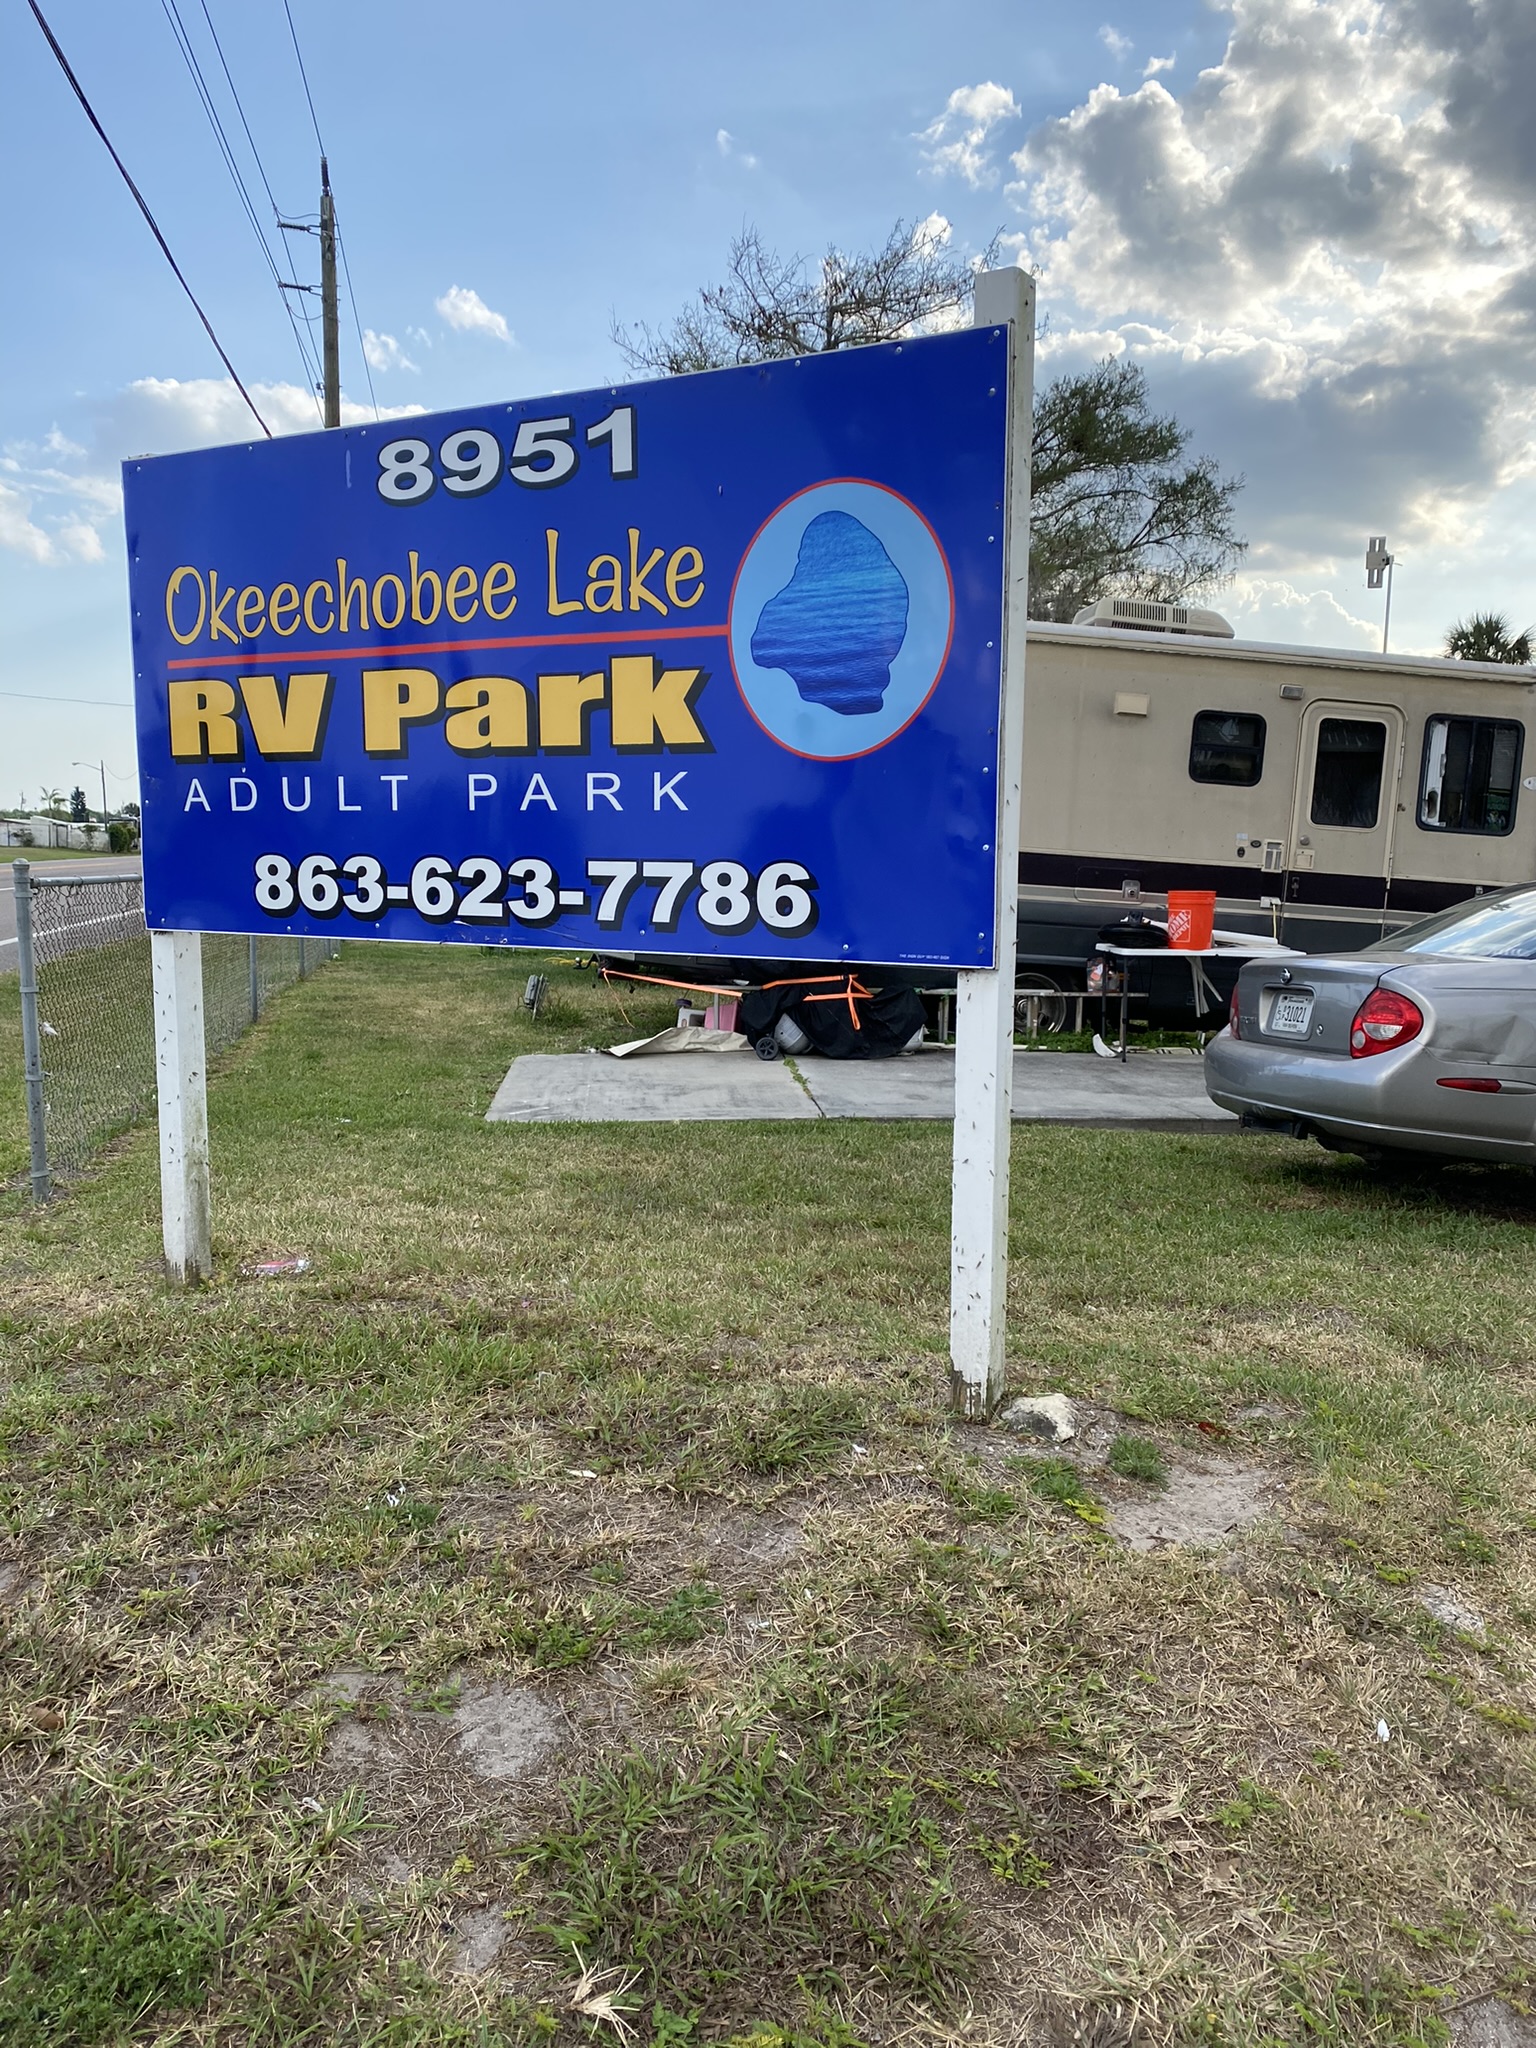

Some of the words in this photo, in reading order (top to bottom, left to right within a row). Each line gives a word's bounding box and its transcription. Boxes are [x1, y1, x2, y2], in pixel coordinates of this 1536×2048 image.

[376, 406, 636, 504] 8951
[166, 551, 517, 645] Okeechobee
[546, 528, 706, 616] Lake
[168, 672, 332, 759] RV
[362, 655, 711, 753] Park
[184, 775, 409, 812] ADULT
[468, 771, 689, 811] PARK
[255, 854, 815, 932] 863-623-7786
